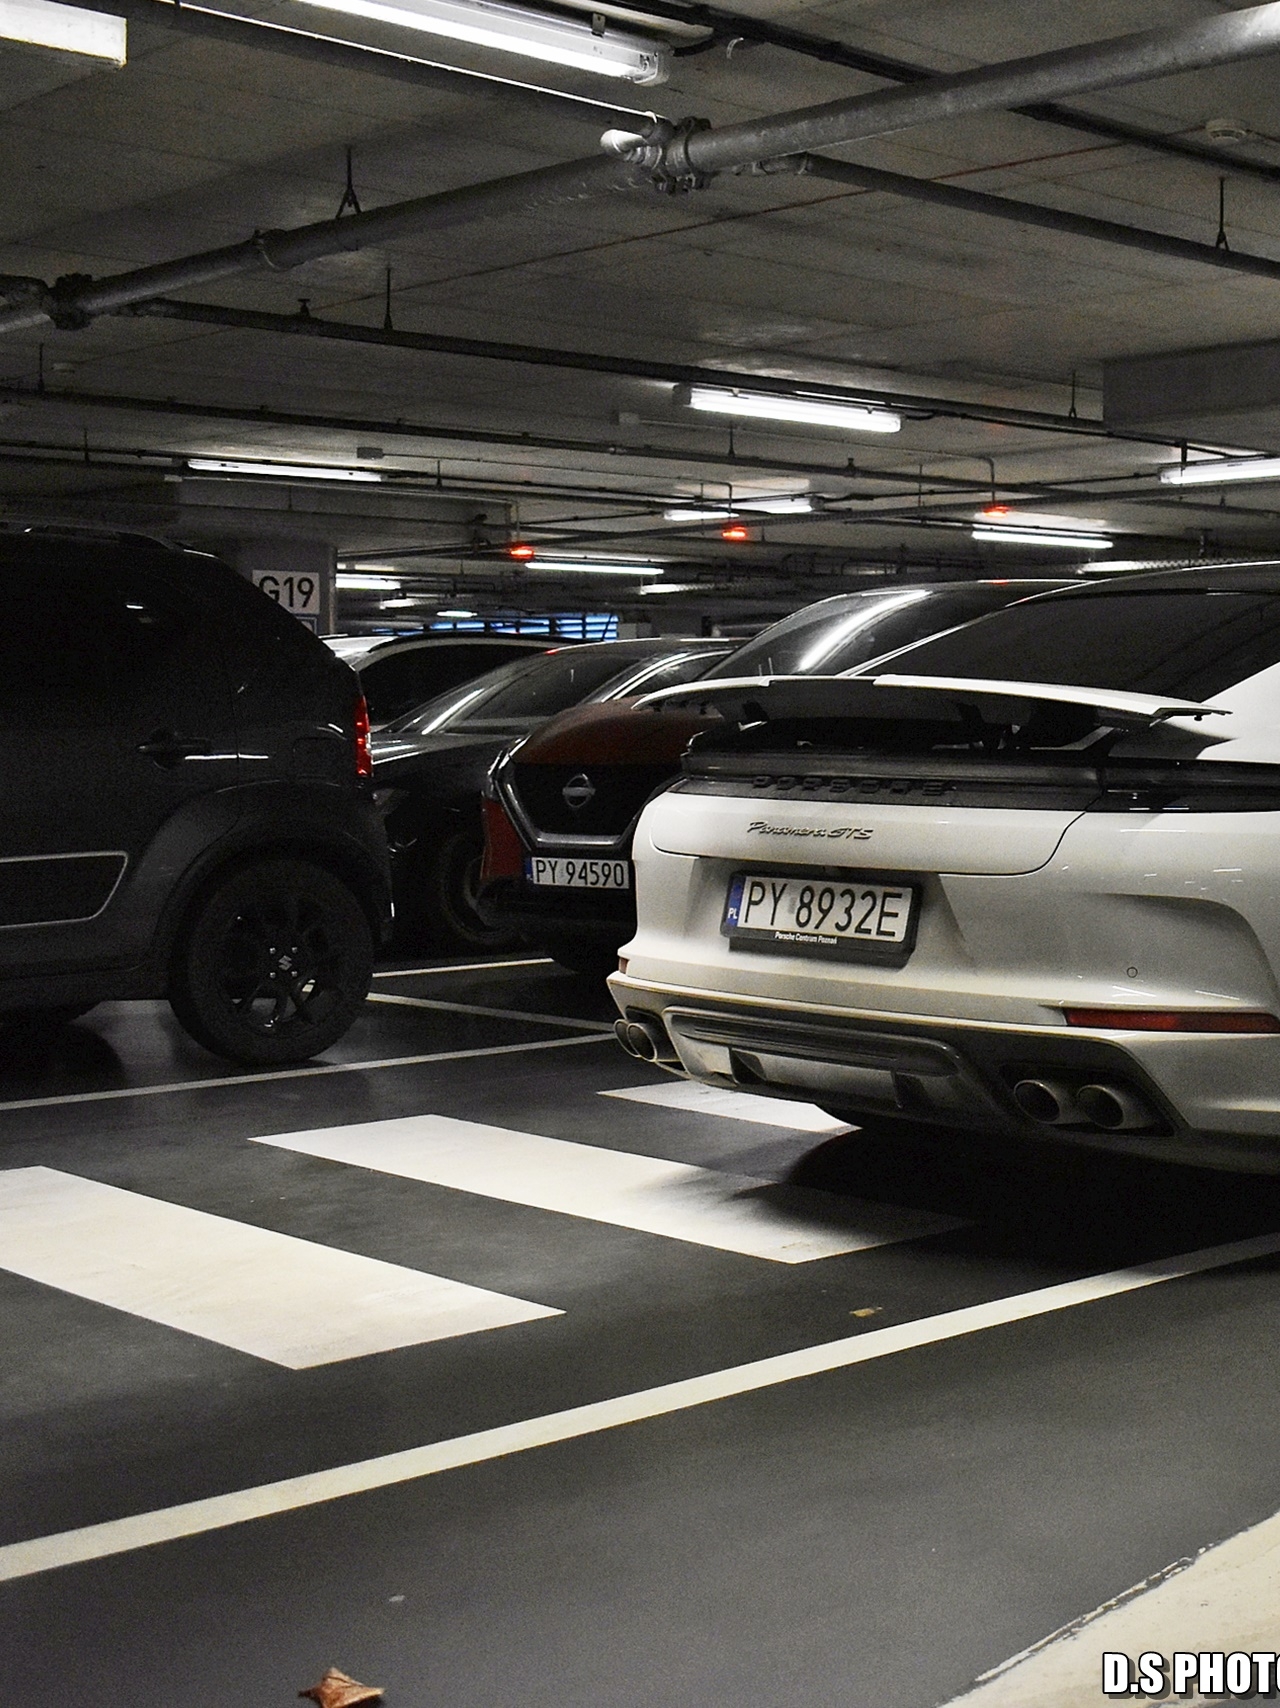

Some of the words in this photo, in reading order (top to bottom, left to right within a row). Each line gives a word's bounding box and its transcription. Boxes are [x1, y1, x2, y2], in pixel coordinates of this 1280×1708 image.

[259, 575, 315, 608] G19
[747, 821, 827, 838] Panamera
[827, 827, 874, 840] GTS
[535, 859, 558, 884] PY
[565, 860, 625, 887] 94590
[728, 907, 738, 920] PL
[743, 881, 788, 926] PY
[795, 885, 903, 937] 8932E
[775, 931, 795, 941] Porsche
